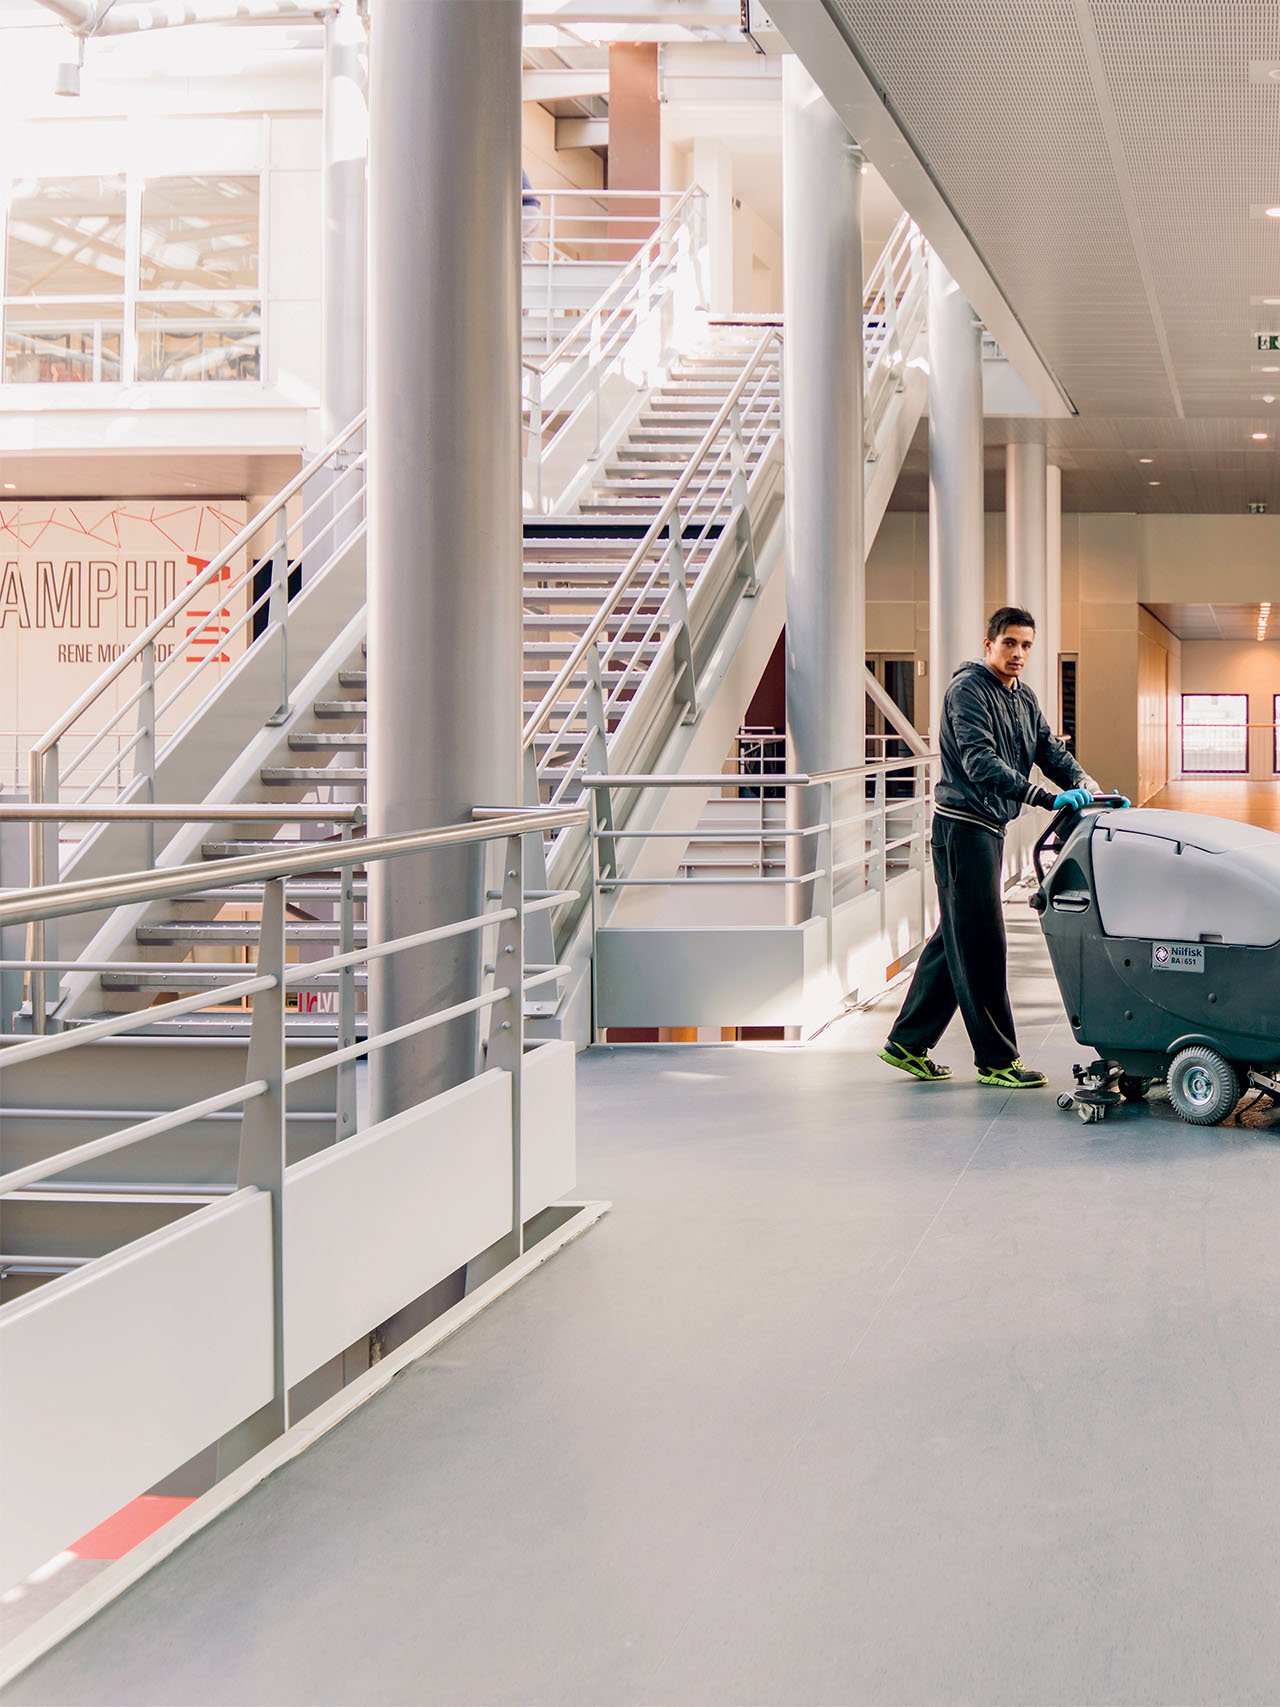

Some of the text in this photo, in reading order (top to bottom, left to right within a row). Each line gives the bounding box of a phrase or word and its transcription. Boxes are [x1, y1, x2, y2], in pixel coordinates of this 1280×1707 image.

[0, 560, 176, 629] AMPHI
[58, 643, 93, 663] RENE
[1171, 947, 1202, 958] Nilfisk
